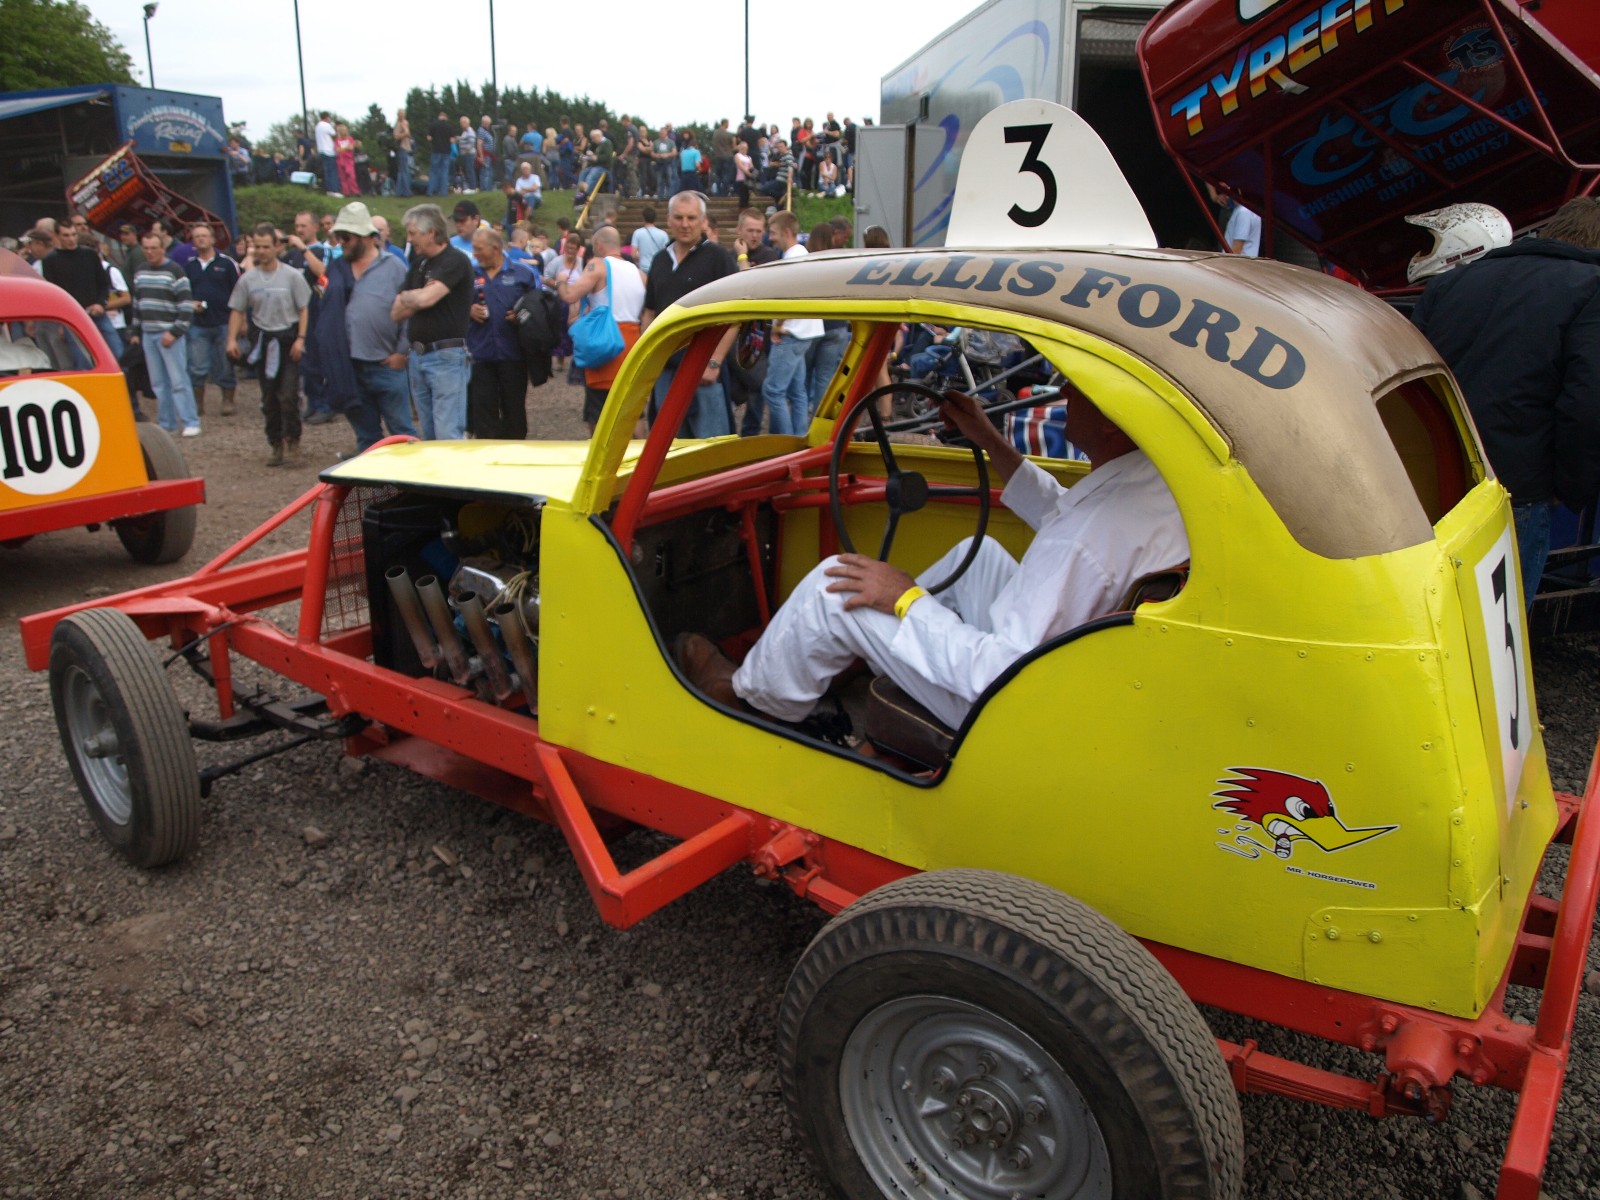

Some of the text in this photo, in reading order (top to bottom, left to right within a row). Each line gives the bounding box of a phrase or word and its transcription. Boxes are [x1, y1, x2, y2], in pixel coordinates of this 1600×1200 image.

[1170, 0, 1405, 136] TYREFI
[1003, 122, 1058, 229] 3
[845, 254, 1307, 391] ELLIS FORD
[0, 399, 85, 479] 100
[1491, 553, 1519, 750] 3
[1286, 865, 1376, 889] MR. HORSEPOWER
